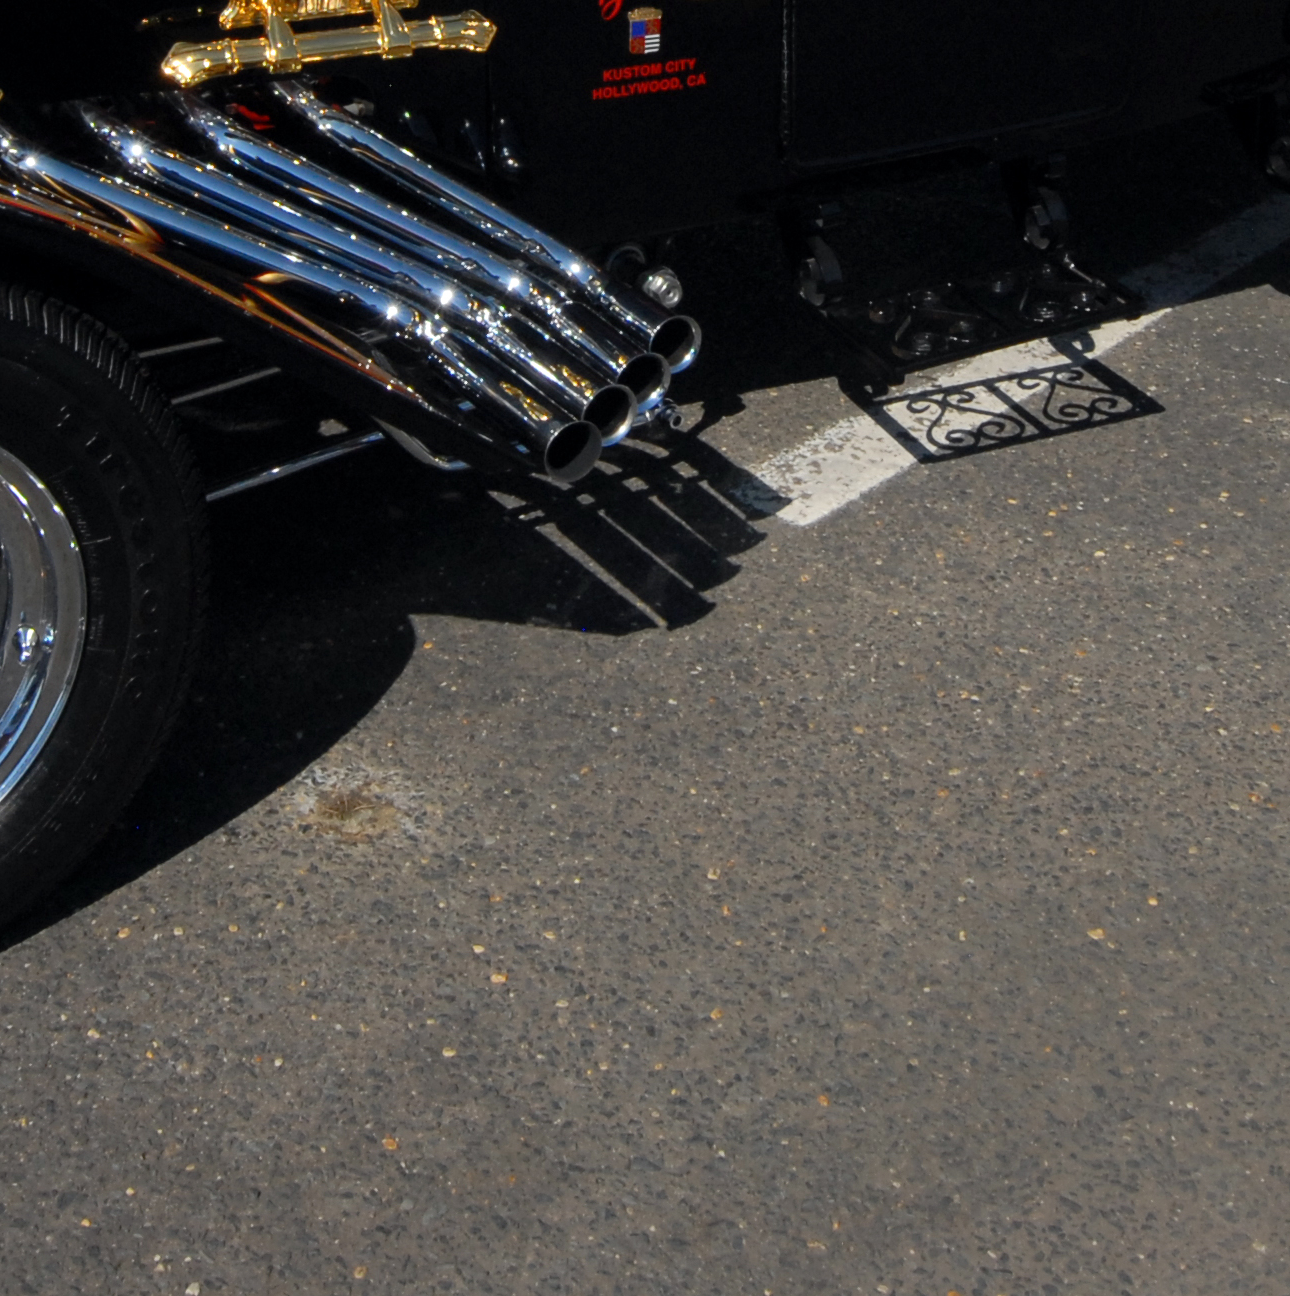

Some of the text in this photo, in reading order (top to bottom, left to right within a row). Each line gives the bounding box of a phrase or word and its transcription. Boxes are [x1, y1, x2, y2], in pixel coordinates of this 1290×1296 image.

[602, 57, 697, 82] KUSTOM CITY
[686, 72, 707, 87] CA
